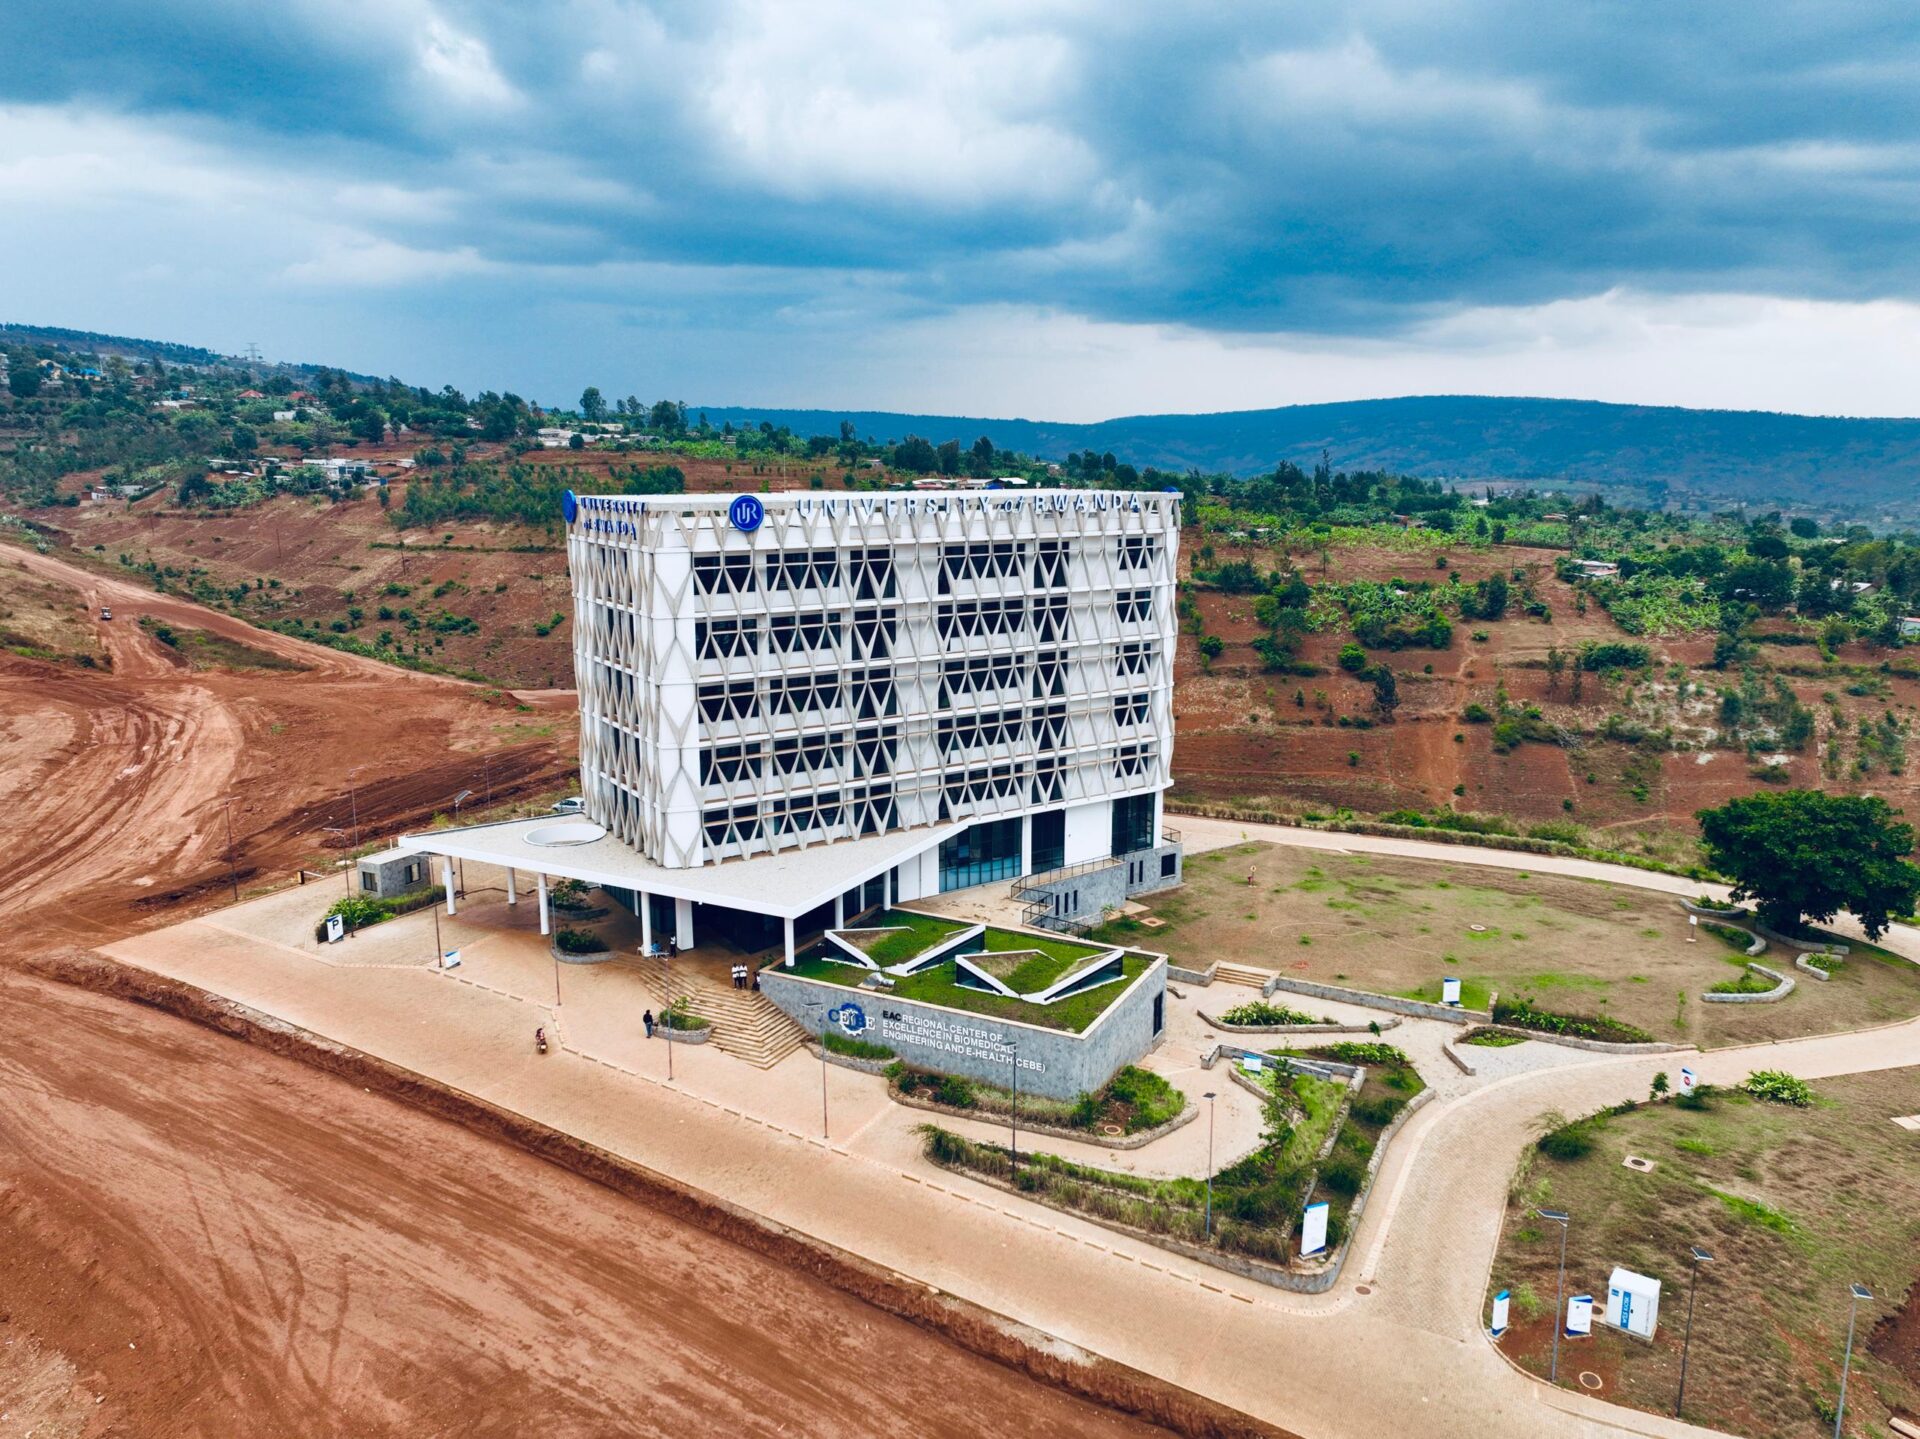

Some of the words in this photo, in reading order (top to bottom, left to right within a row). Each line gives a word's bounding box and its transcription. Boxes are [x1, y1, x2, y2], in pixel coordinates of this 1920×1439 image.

[796, 496, 991, 518] UNIVERSITY
[1004, 495, 1025, 513] of
[1034, 493, 1141, 514] RWANDA
[332, 919, 339, 931] P
[882, 1010, 901, 1021] EAC
[902, 1014, 949, 1032] REGIONAL
[950, 1024, 988, 1039] CENTER
[989, 1032, 1003, 1043] OF
[882, 1020, 942, 1040] EXCELLENCE
[943, 1031, 952, 1042] IN
[954, 1034, 1014, 1054] BIOMEDICAL
[882, 1029, 943, 1050] ENGINEERING
[944, 1042, 965, 1054] AND
[966, 1045, 1013, 1066] E-HEALTH
[1013, 1057, 1046, 1074] CEBE)
